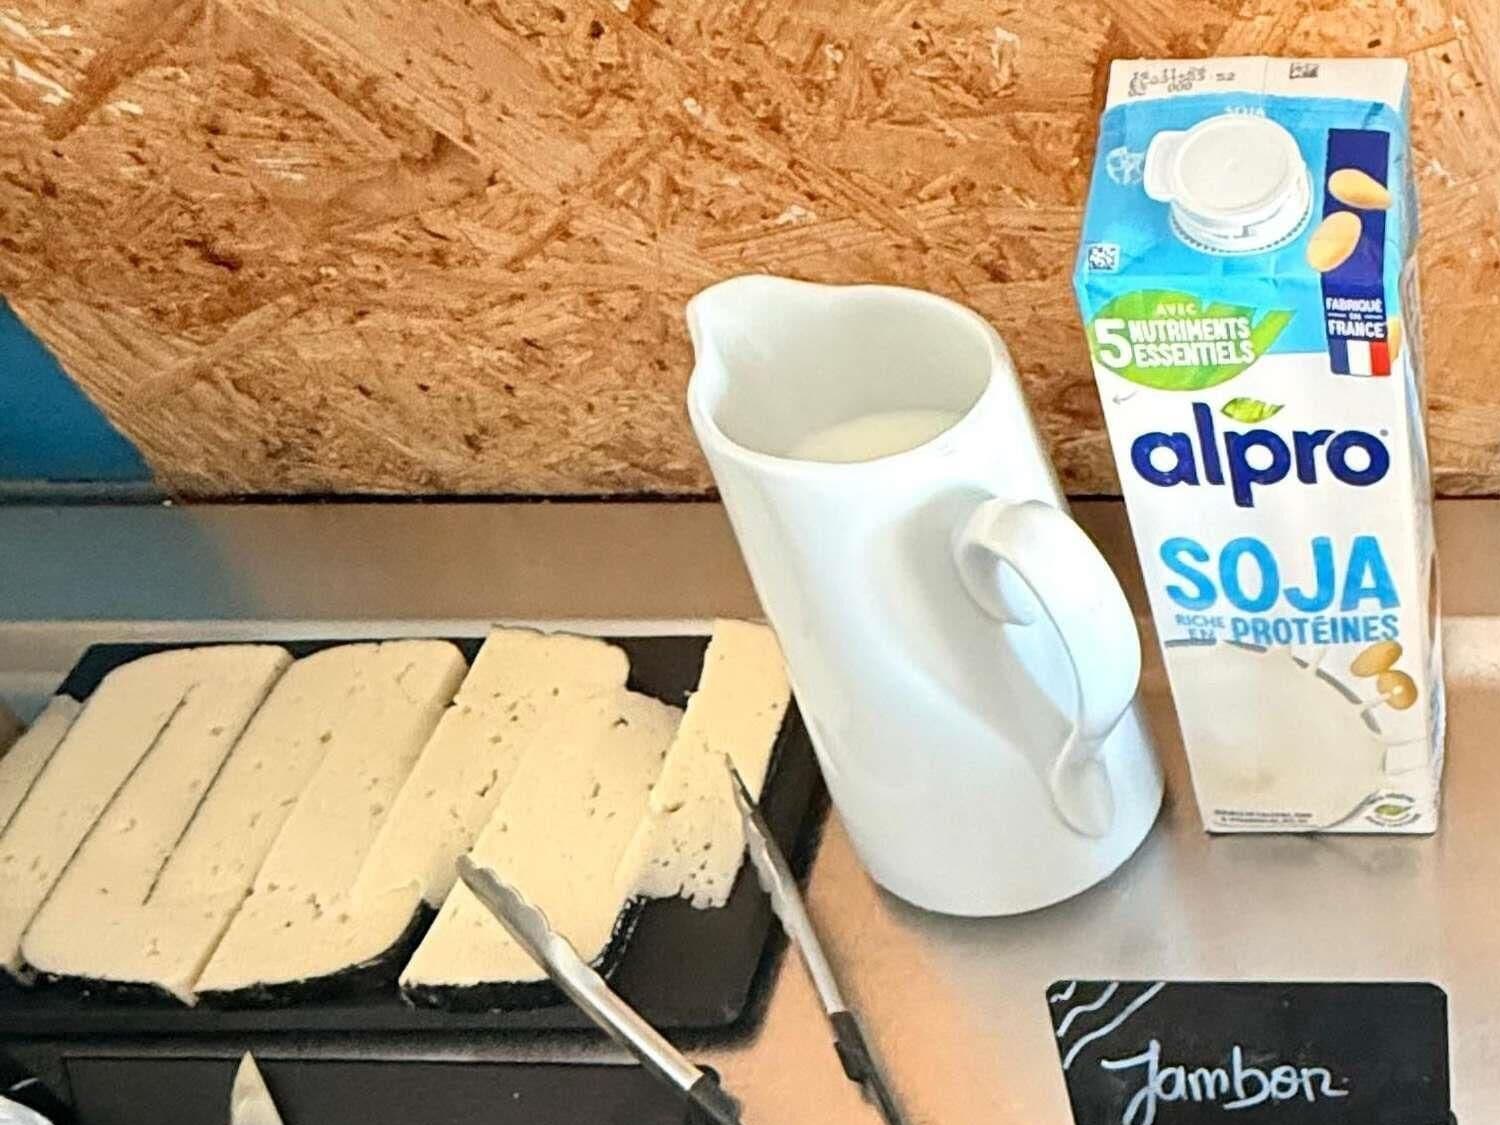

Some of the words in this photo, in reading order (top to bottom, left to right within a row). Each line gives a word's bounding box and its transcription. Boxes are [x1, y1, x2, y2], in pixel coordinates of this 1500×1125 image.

[1094, 318, 1133, 369] 5
[1127, 317, 1250, 343] NUTRIMENTS
[1328, 319, 1385, 338] FRANCE
[1133, 340, 1255, 368] ESSENTIELS
[1130, 402, 1391, 508] alpro
[1159, 535, 1401, 613] SOJA
[1231, 614, 1400, 646] PROTÉINES
